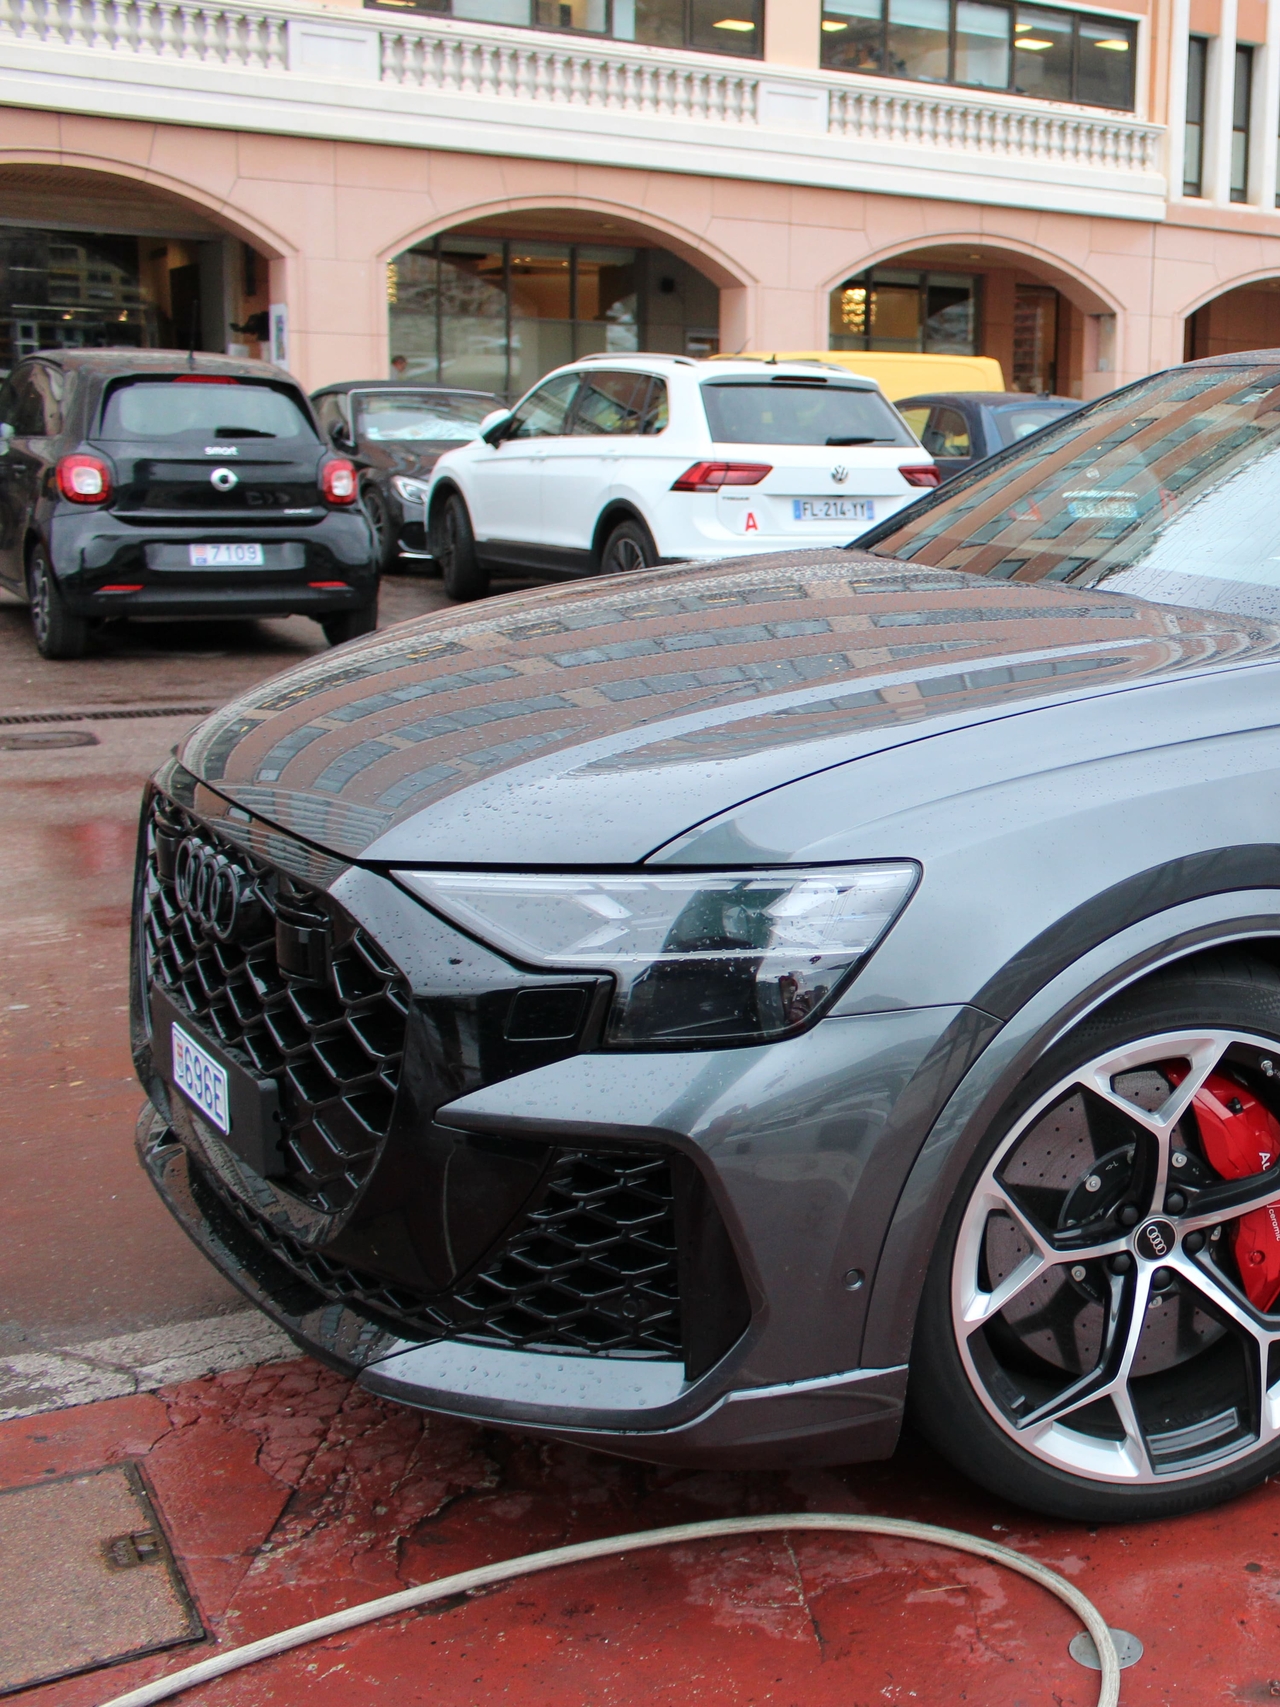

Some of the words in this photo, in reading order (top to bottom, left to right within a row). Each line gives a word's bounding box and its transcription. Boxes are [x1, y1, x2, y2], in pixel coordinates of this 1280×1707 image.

[204, 446, 238, 455] smart
[802, 501, 866, 517] FL-214-YY
[745, 512, 759, 532] A
[209, 545, 257, 561] 7109
[185, 1045, 224, 1121] 696E
